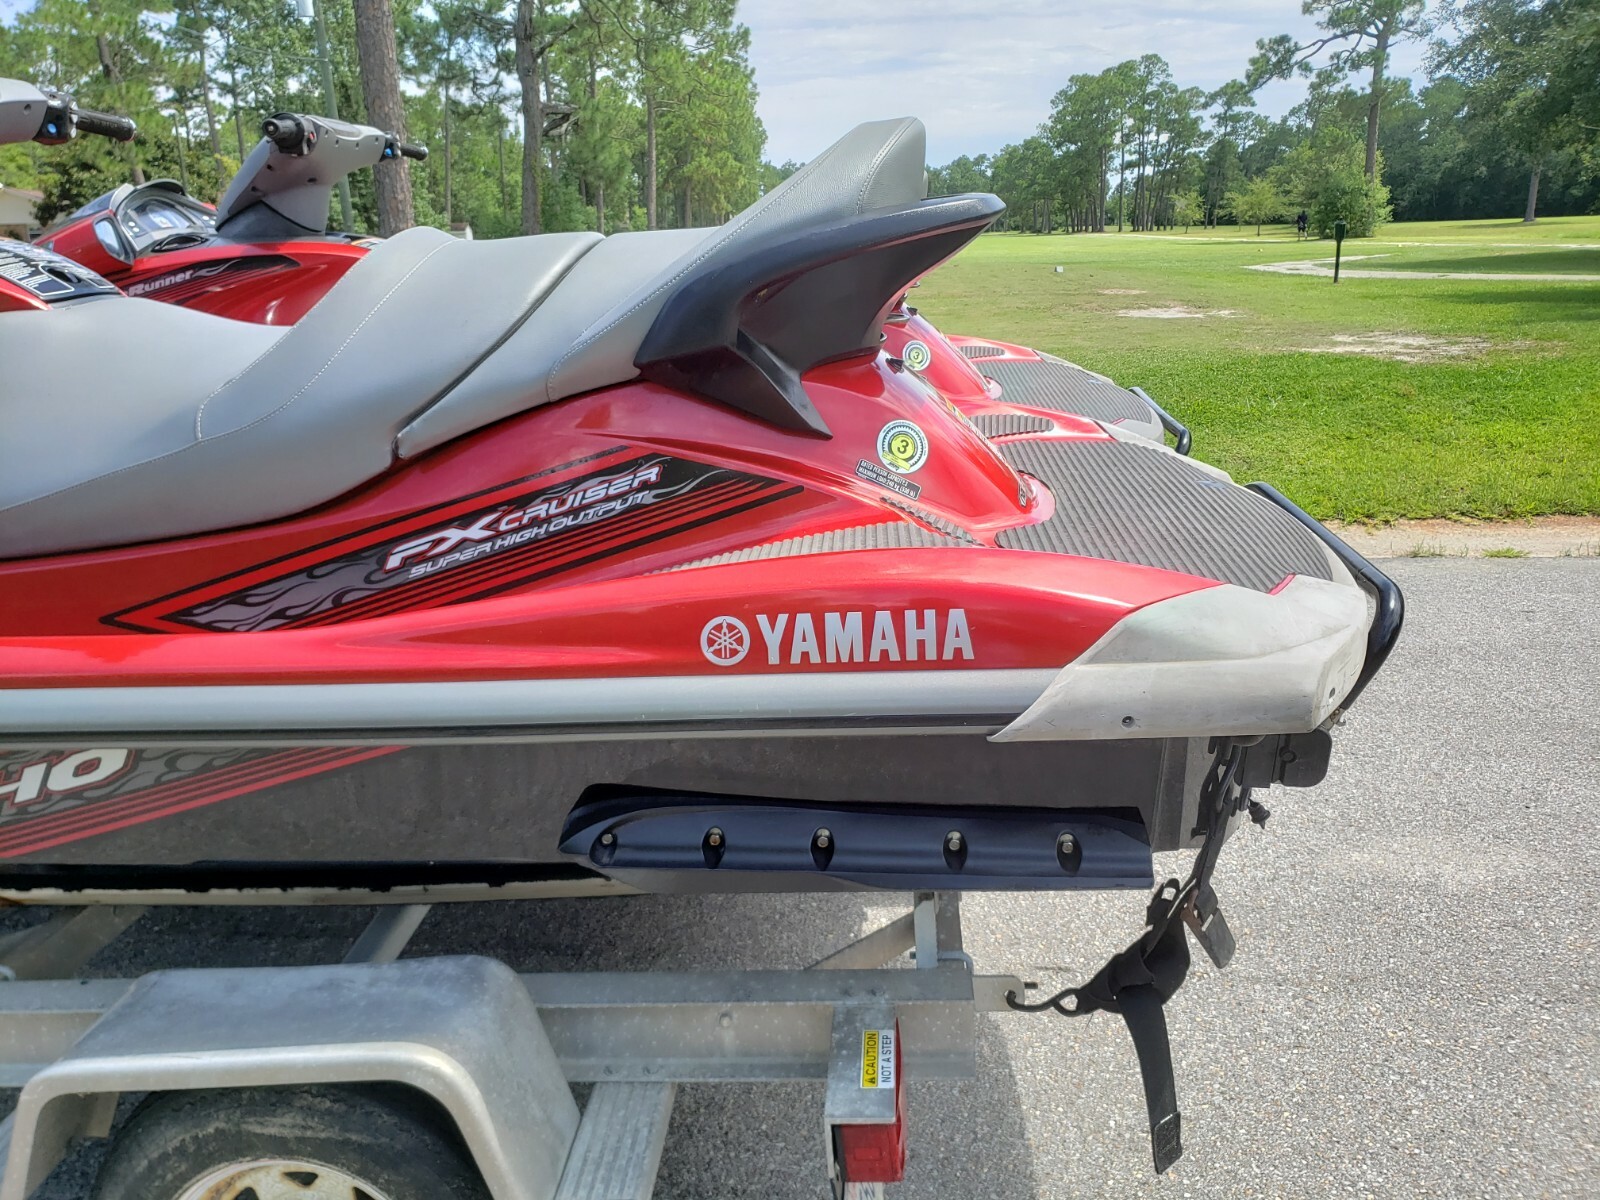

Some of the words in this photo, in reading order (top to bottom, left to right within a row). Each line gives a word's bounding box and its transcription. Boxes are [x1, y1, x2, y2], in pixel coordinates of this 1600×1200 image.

[124, 270, 194, 297] Runner
[913, 351, 920, 360] 3
[897, 439, 909, 454] 3
[385, 510, 504, 571] FX
[499, 466, 661, 531] CRUISER
[408, 543, 493, 579] SUPER
[494, 525, 546, 550] HIGH
[548, 490, 650, 533] OUTPUT
[755, 608, 975, 665] YAMAHA
[865, 1033, 877, 1076] CAUTION
[881, 1034, 892, 1055] STEP
[881, 1065, 892, 1083] NOT
